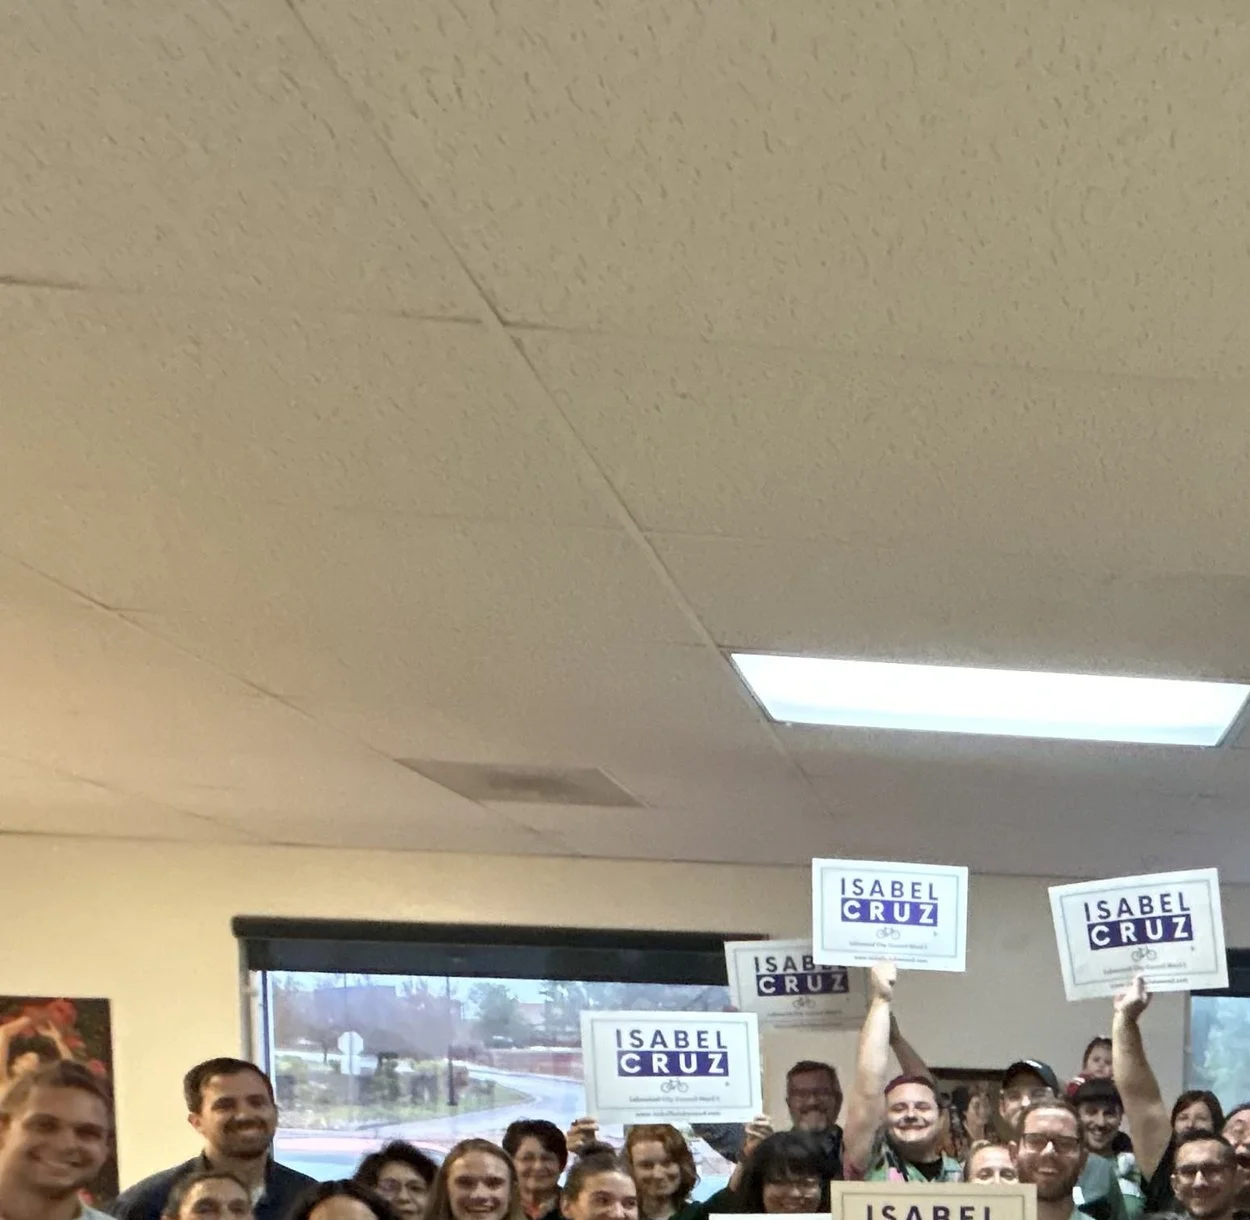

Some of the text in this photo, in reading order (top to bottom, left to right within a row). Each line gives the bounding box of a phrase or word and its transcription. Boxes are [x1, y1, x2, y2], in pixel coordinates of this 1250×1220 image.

[841, 877, 938, 900] ISABEL
[843, 900, 934, 924] CRUZ
[1084, 892, 1190, 921] ISABEL
[1091, 917, 1188, 945] CRUZ
[755, 956, 848, 972] ISAB
[759, 974, 846, 993] CRUZ
[616, 1029, 727, 1049] ISABEL
[620, 1053, 724, 1073] CRUZ
